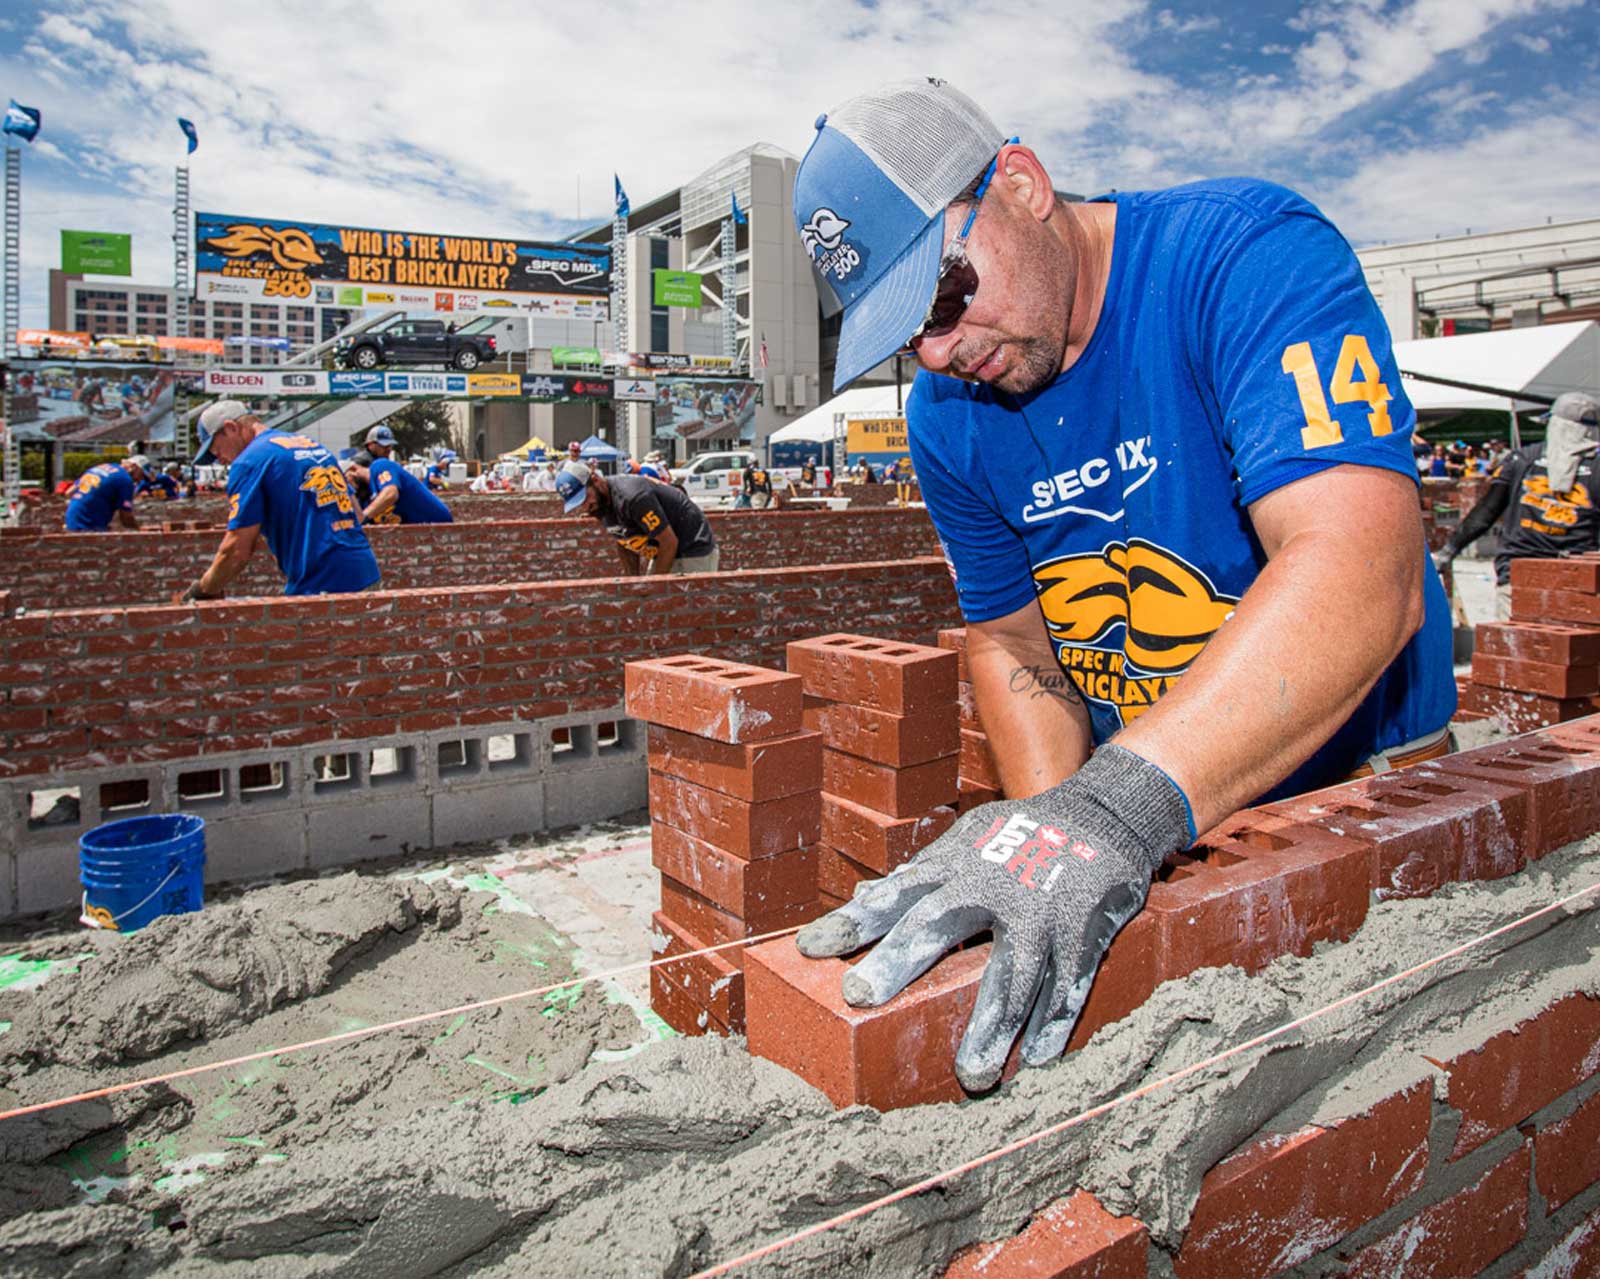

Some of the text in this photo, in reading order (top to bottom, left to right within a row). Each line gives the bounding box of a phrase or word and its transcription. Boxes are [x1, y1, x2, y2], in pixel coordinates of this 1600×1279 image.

[340, 229, 517, 266] WHO IS THE WORLD'S
[348, 255, 510, 289] BEST BRICKLAYER?
[531, 259, 597, 274] SPEC MIX
[833, 249, 860, 280] 500
[262, 278, 312, 299] 500
[210, 373, 264, 386] BELDEN
[1281, 334, 1393, 450] 14
[863, 420, 905, 433] WHO IS THE
[641, 510, 661, 532] 15
[1061, 647, 1104, 670] SPEC
[981, 813, 1040, 863] CUT
